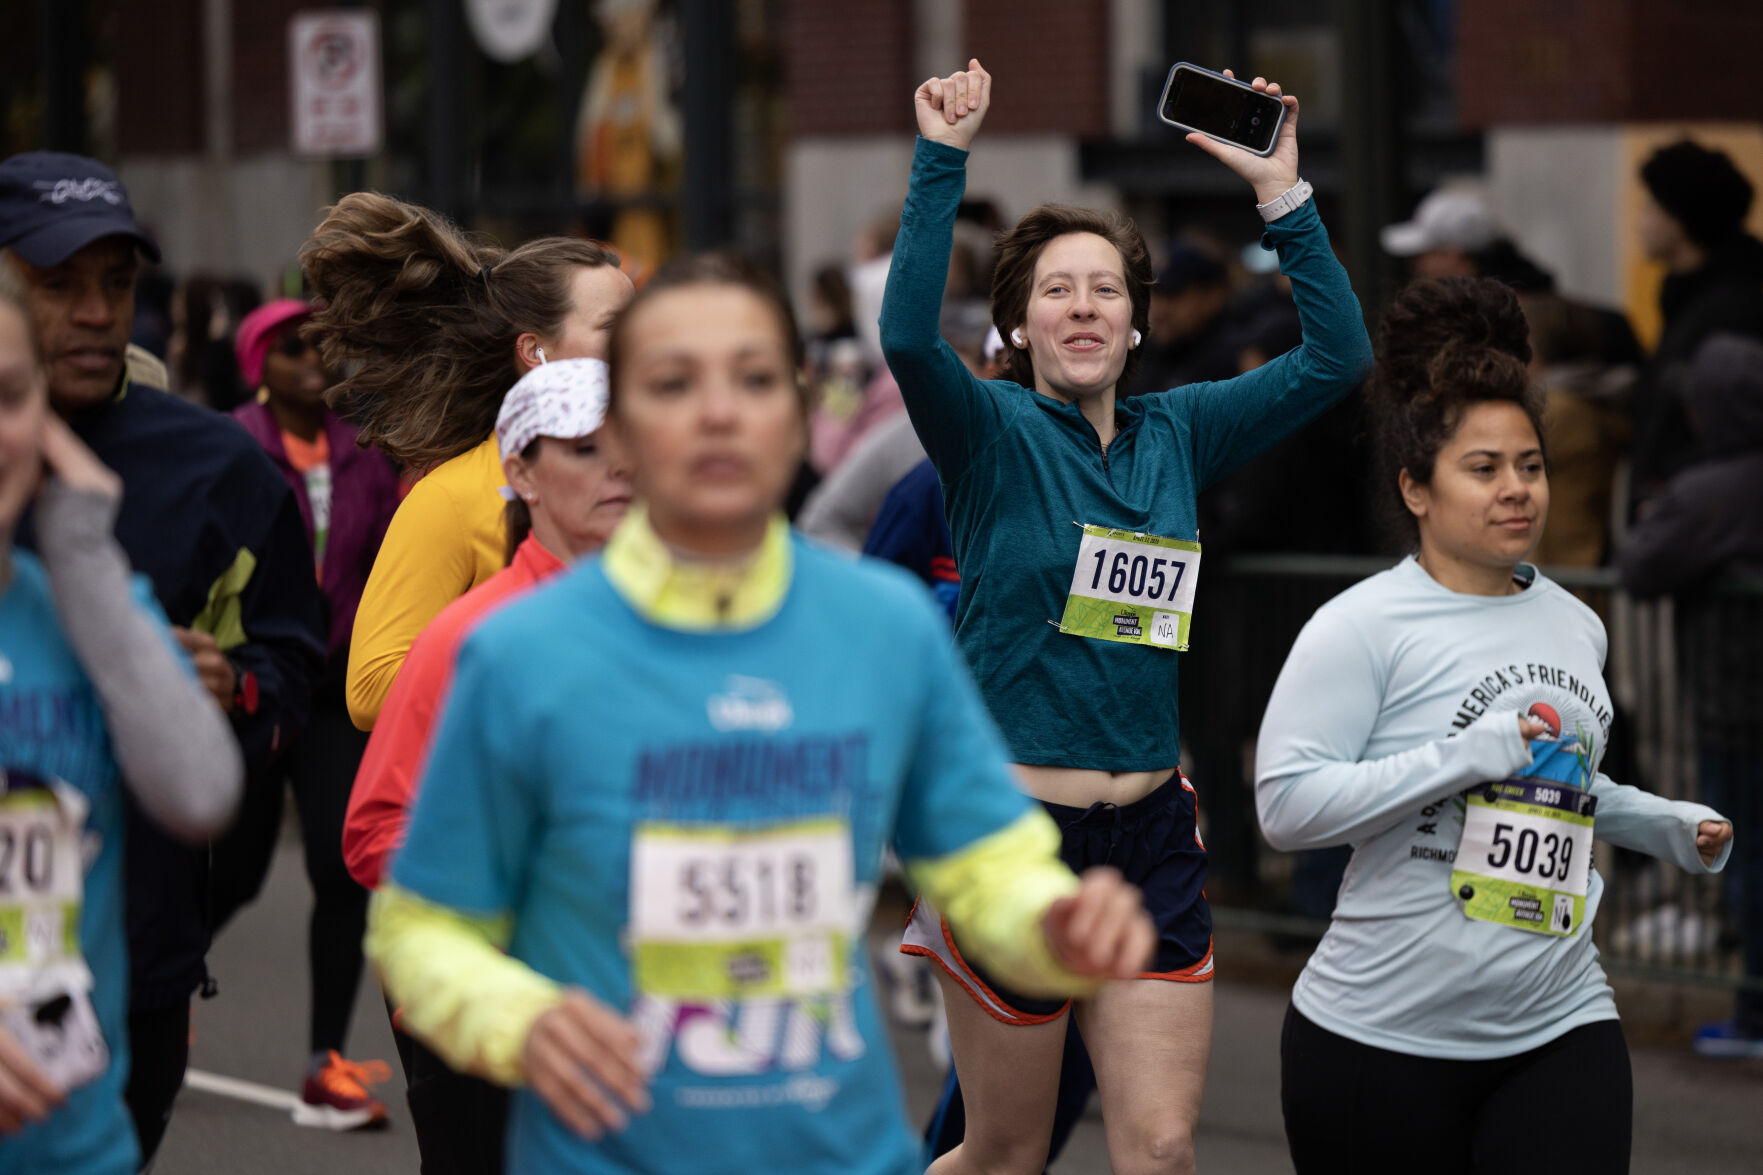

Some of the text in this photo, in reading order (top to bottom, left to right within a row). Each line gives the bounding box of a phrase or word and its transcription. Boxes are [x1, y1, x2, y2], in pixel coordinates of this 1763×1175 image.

[1091, 549, 1186, 601] 16057
[1158, 623, 1174, 639] NA
[1447, 664, 1611, 749] MERICA'S FRIENDLIES
[1535, 786, 1561, 805] 5039
[1410, 845, 1458, 865] RICHMO
[1487, 823, 1574, 882] 5039
[680, 852, 818, 928] 5518
